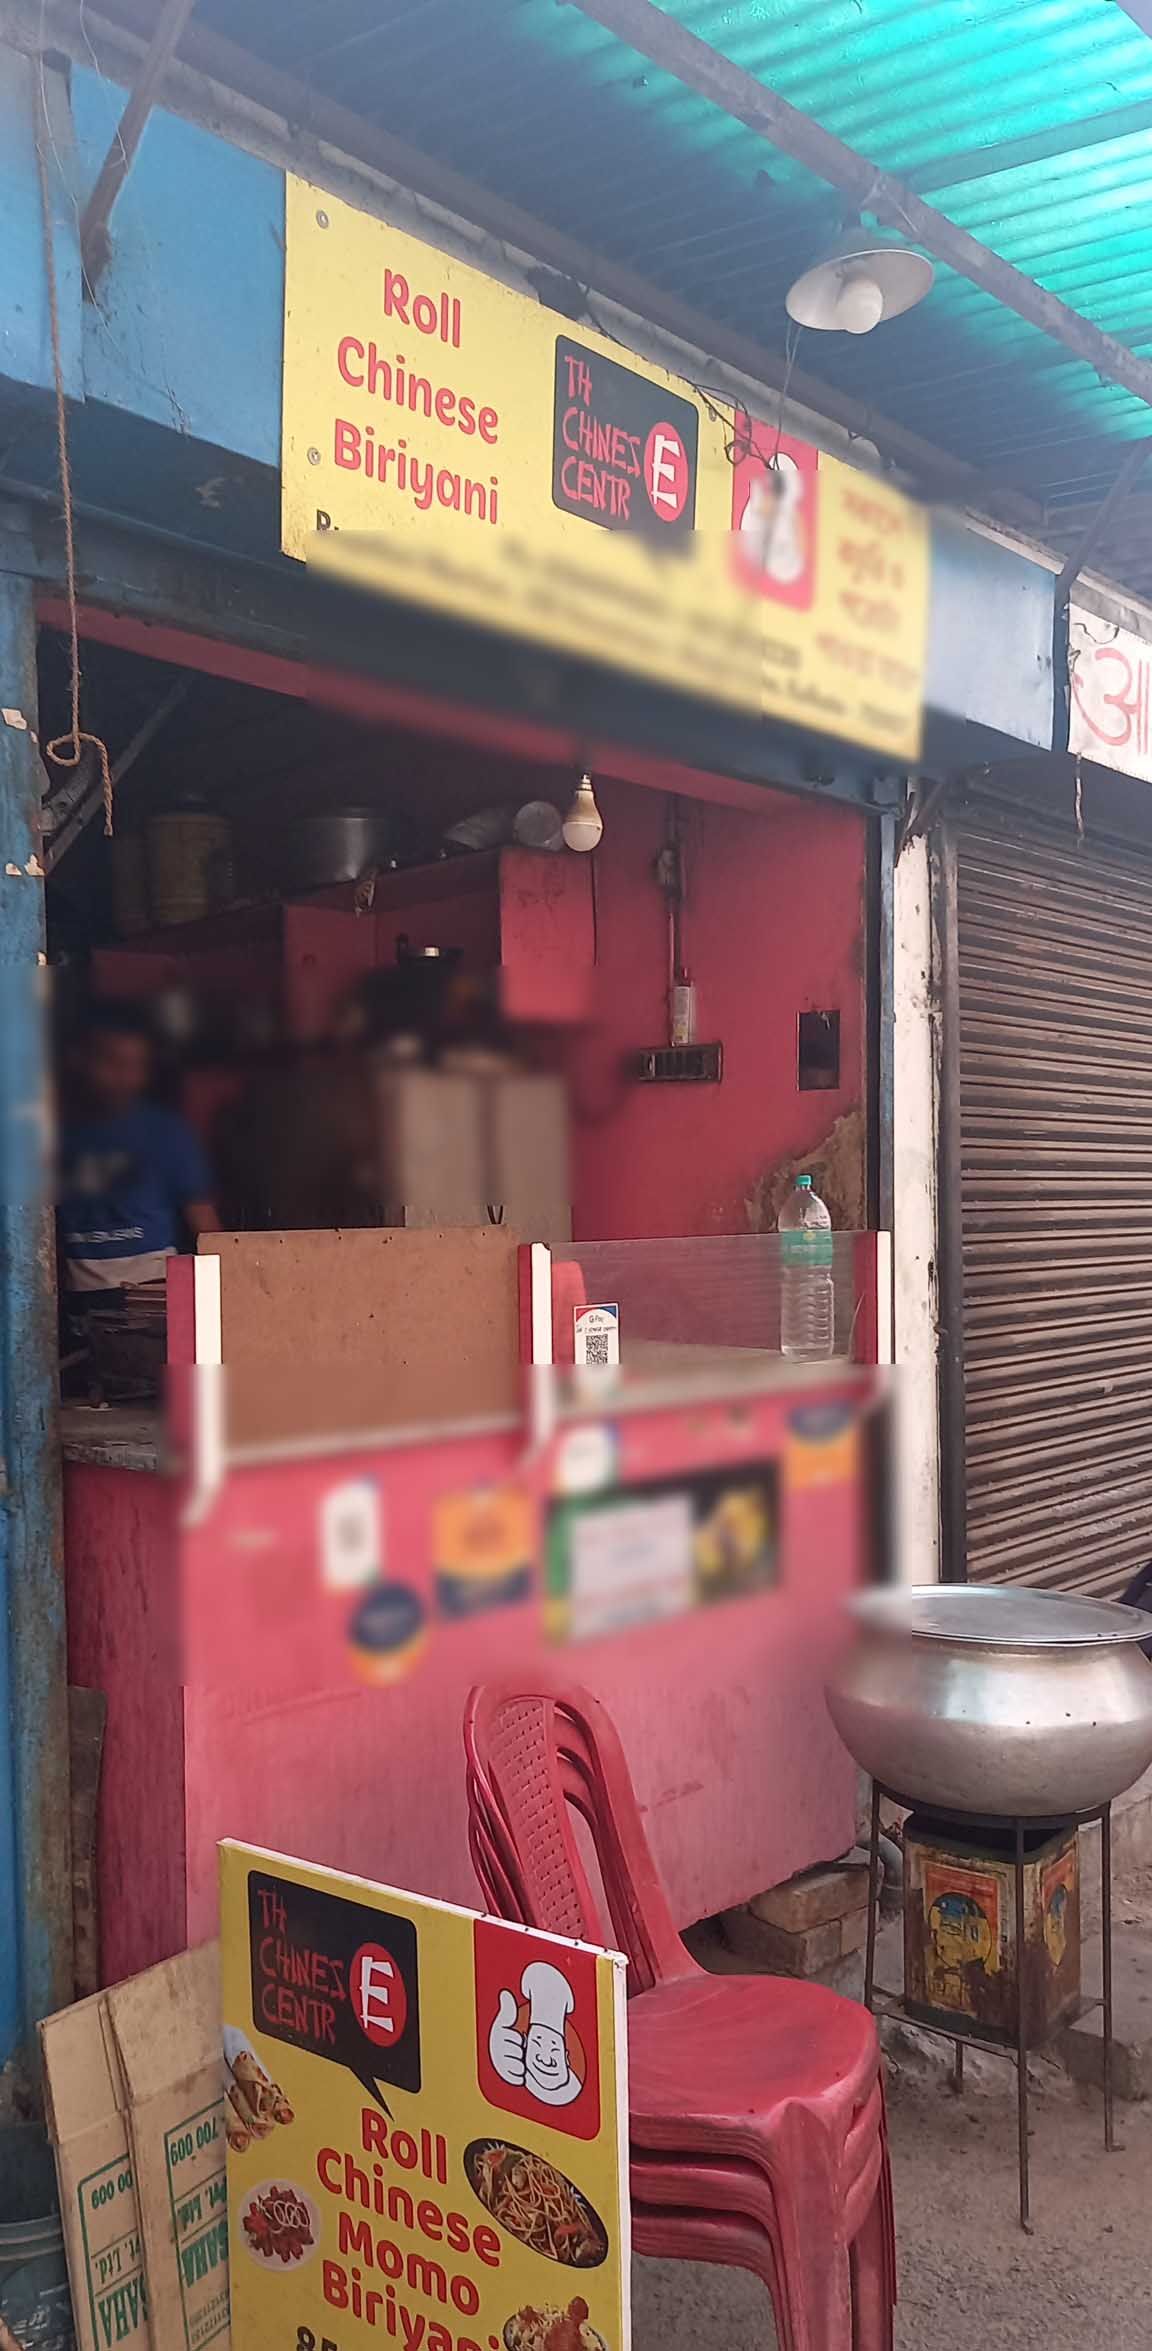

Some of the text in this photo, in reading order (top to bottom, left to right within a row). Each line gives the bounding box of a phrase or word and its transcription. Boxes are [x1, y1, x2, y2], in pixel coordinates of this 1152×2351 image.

[383, 268, 461, 348] Roll
[337, 336, 499, 444] Chinese
[564, 355, 593, 407] TH
[334, 418, 499, 525] Biriyani
[562, 407, 641, 479] CHINES
[561, 455, 631, 521] CENTR
[257, 1885, 287, 1935] TH
[260, 1936, 346, 2000] CHINES
[262, 1983, 336, 2045] CENTR
[361, 2107, 448, 2185] Roll
[317, 2148, 501, 2268] Chinese
[339, 2211, 480, 2316] Momo
[322, 2259, 500, 2351] Biriya
